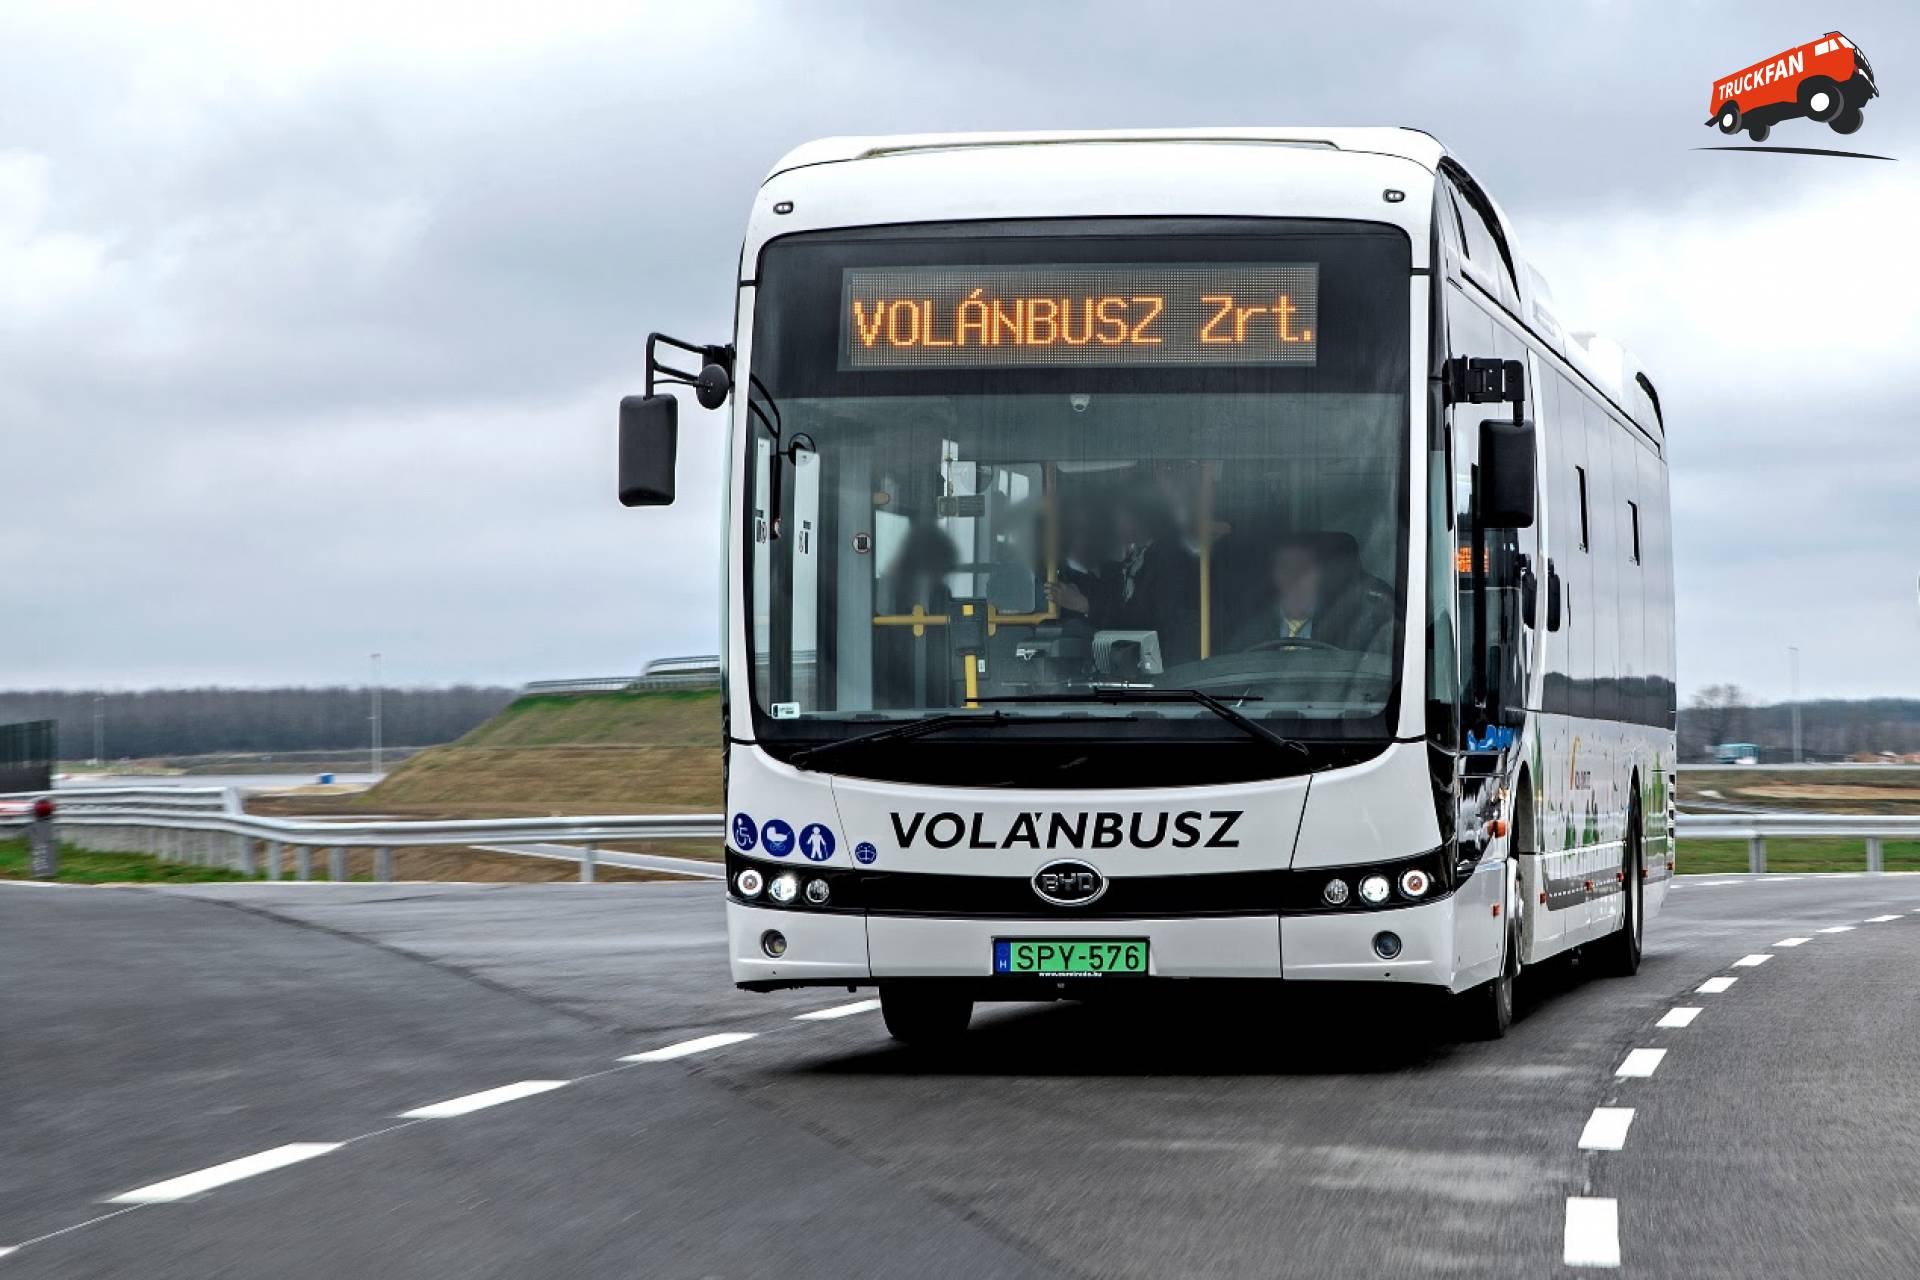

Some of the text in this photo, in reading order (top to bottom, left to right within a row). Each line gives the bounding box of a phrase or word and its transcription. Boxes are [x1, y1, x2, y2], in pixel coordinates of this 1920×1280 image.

[853, 289, 1314, 346] VOLÁNBUSZ Zrt.
[890, 811, 1244, 848] VOLÁNBUSZ
[1041, 872, 1094, 892] BYD
[999, 945, 1139, 970] H SPY-576
